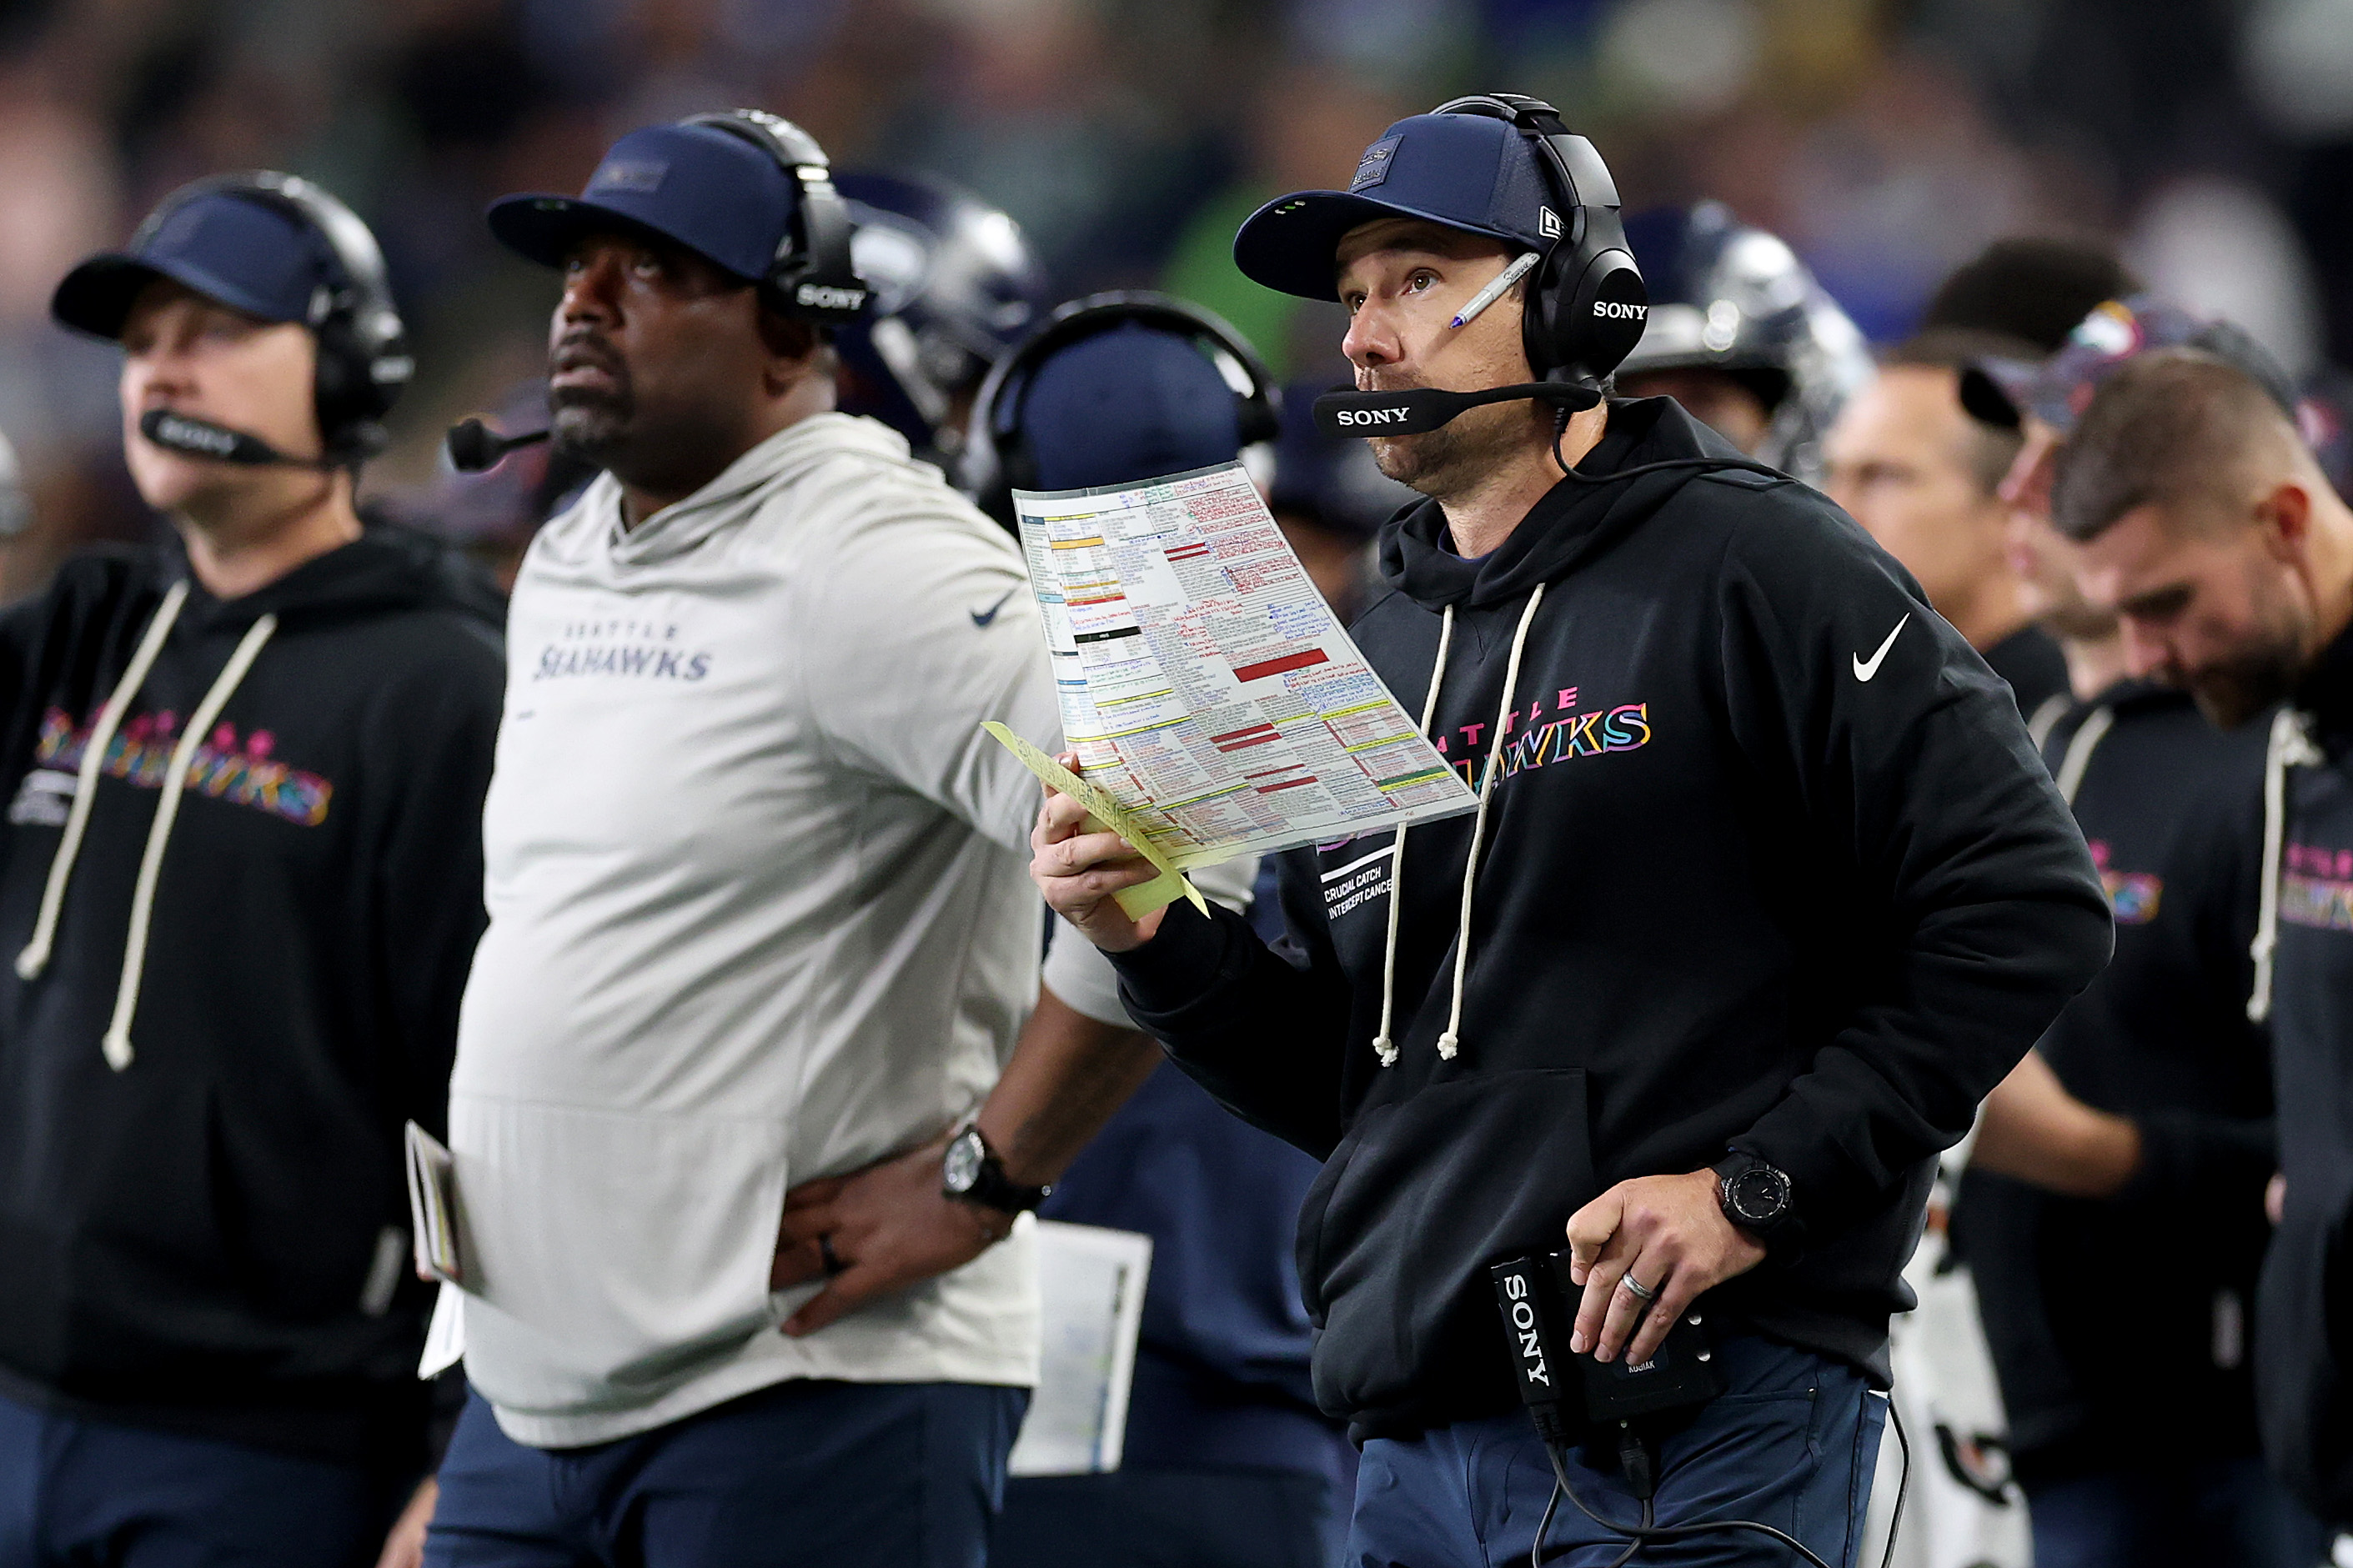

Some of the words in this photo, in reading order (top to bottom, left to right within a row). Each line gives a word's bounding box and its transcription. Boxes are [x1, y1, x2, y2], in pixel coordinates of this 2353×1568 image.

[796, 283, 866, 310] SONY
[1593, 301, 1648, 320] SONY
[1337, 407, 1410, 426] SONY
[1436, 686, 1579, 754] ATTLE
[1324, 878, 1356, 903] CRUCIAL
[1356, 865, 1382, 888] CATCH
[1327, 890, 1364, 920] INTERCEPT
[1364, 879, 1392, 900] CANCE
[1504, 1274, 1550, 1387] SONY
